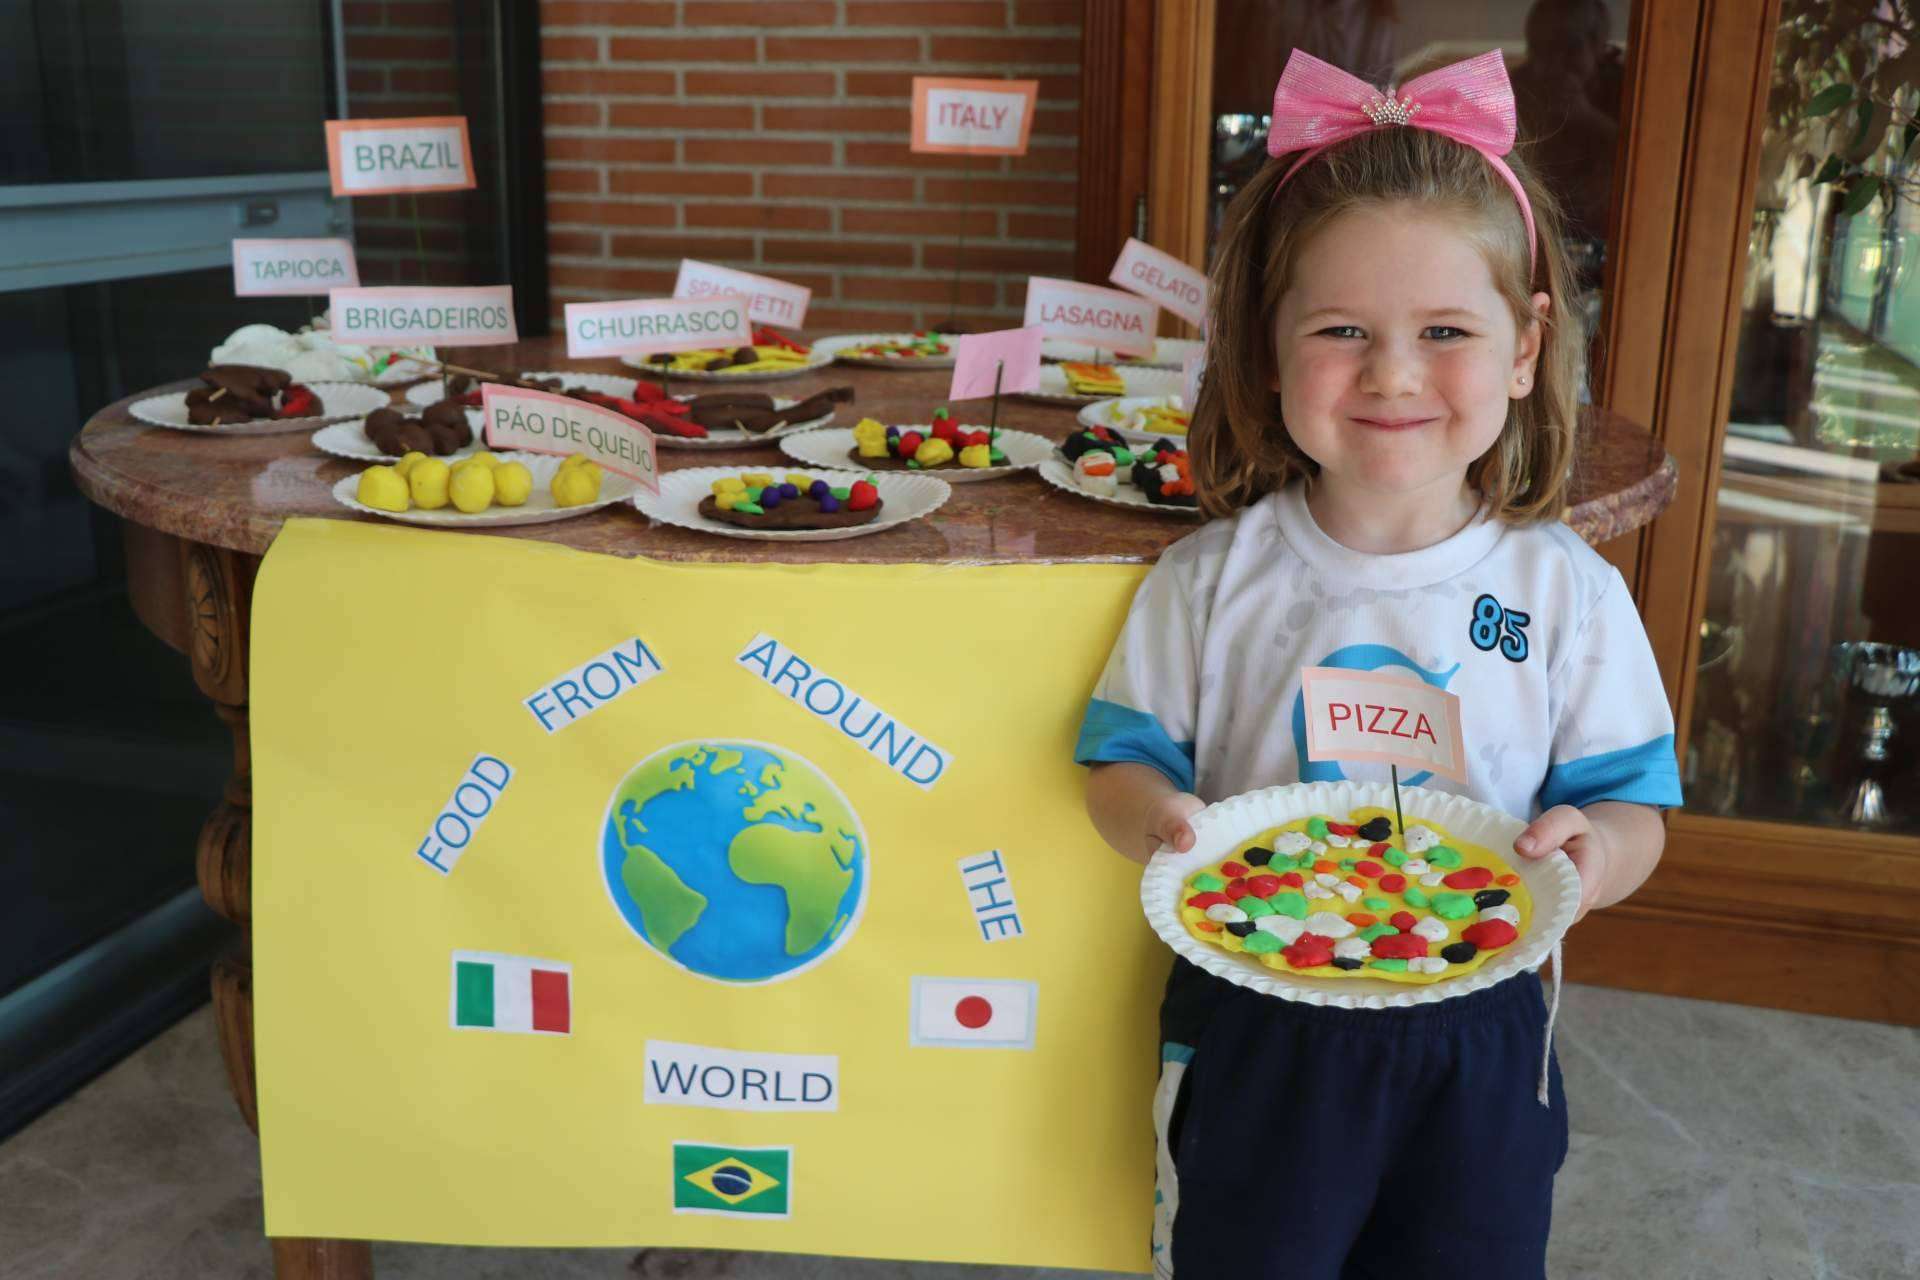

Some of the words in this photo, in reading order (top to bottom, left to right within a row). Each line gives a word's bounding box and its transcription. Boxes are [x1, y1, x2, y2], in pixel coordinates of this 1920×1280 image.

[938, 101, 1009, 132] ITALY
[355, 141, 460, 172] BRAZIL
[251, 258, 346, 280] TAPIOCA
[1131, 260, 1202, 305] GELATO
[345, 305, 509, 331] BRIGADEIROS
[577, 308, 739, 340] CHURRASCO
[1040, 303, 1144, 334] LASAGNA
[552, 416, 582, 443] DE
[587, 426, 652, 473] QUEIJO
[1469, 593, 1531, 662] 85
[1328, 702, 1437, 745] PIZZA
[416, 754, 512, 873] FOOD
[526, 637, 663, 732] FROM
[738, 639, 945, 787] AROUND
[962, 849, 1022, 941] THE
[650, 1059, 834, 1103] WORLD
